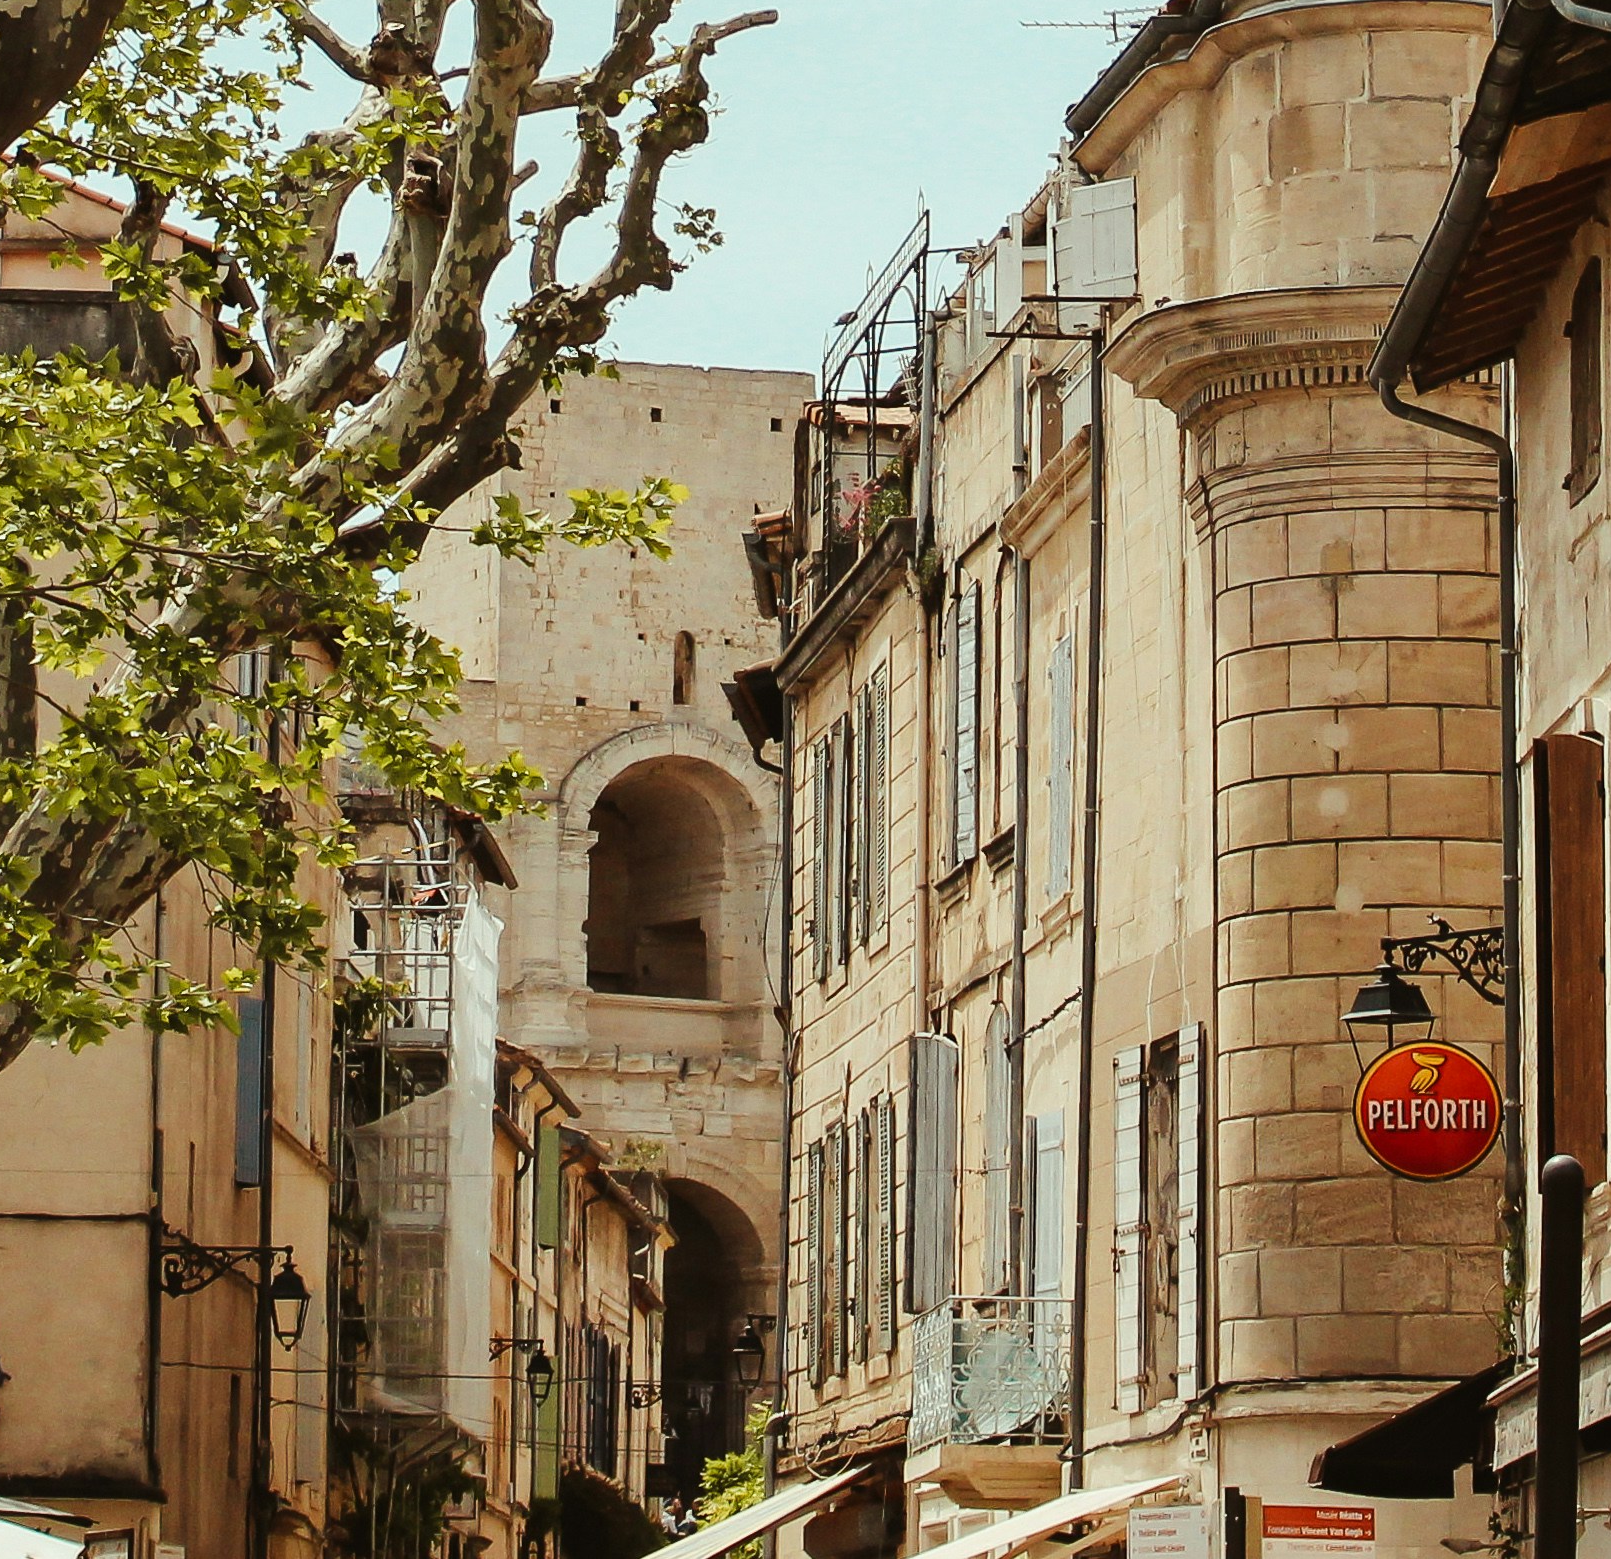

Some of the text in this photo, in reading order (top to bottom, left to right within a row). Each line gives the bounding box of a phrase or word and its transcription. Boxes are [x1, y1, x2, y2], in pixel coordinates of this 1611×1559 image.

[1368, 1098, 1487, 1130] PELFORTH
[1301, 1526, 1328, 1536] Vincent
[1329, 1527, 1344, 1536] Van
